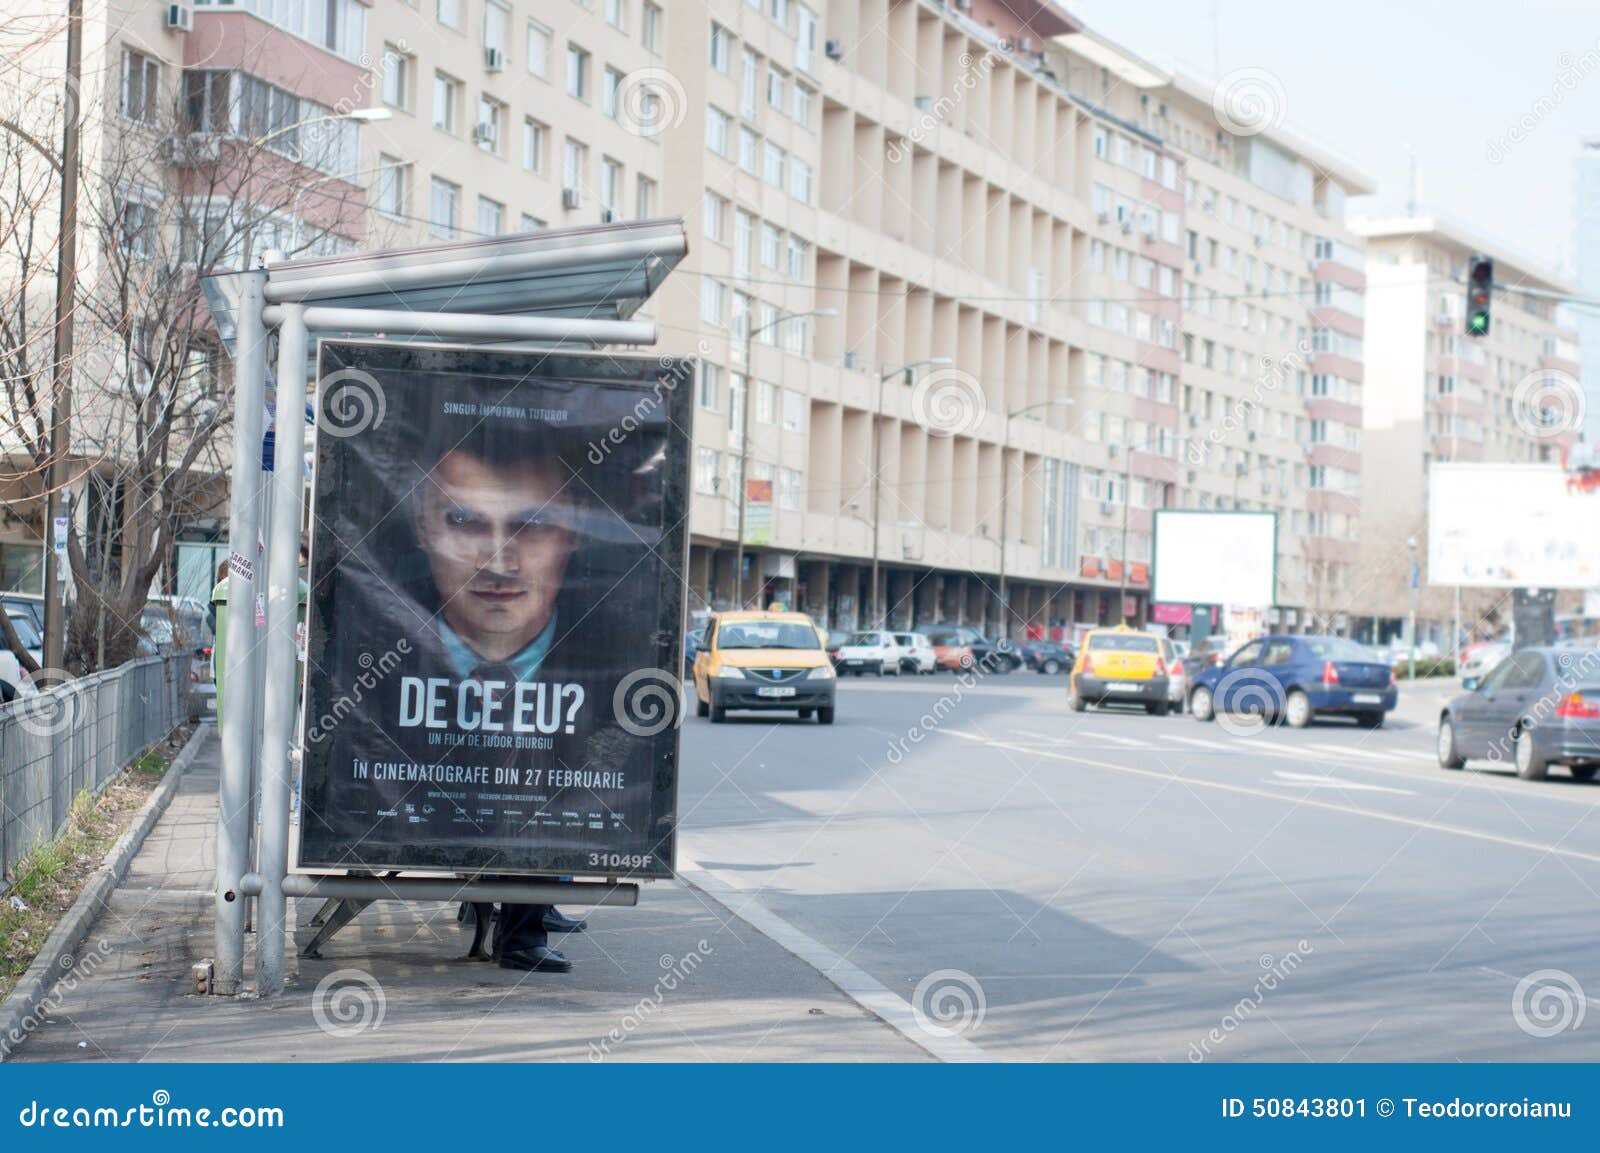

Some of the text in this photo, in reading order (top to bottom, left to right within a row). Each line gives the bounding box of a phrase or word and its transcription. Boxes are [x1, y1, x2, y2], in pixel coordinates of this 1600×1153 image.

[443, 402, 476, 415] SINGUR
[399, 676, 585, 735] DE CE EU?
[428, 732, 554, 750] UN FILM DE TUDOR GIURGIU
[353, 758, 625, 789] ÎN CINEMATOGRAFE DIN 27 FEBRUARIE
[588, 852, 653, 868] 31049F
